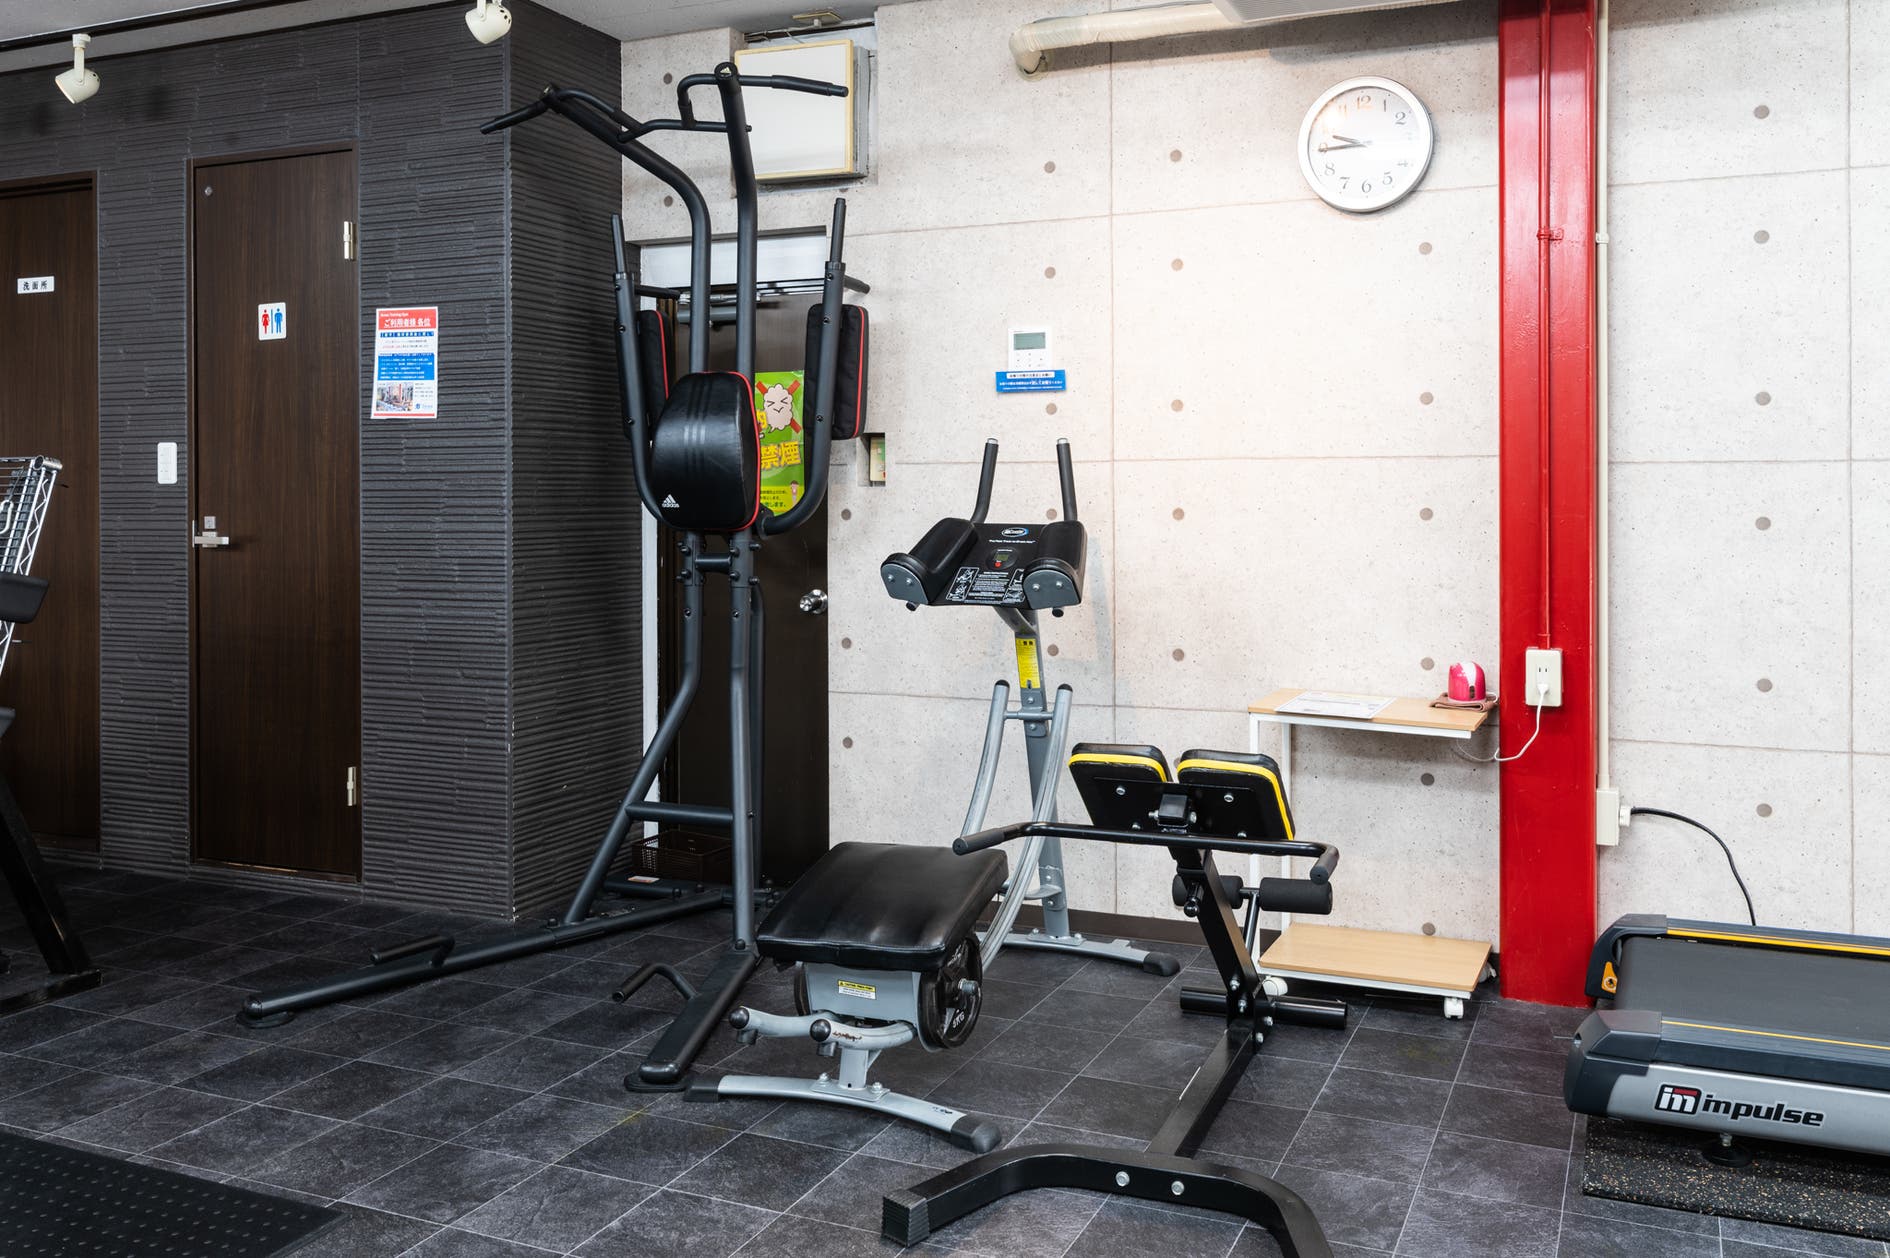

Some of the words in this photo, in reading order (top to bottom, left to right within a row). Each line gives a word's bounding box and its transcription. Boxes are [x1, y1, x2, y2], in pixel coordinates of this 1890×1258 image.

[1357, 96, 1372, 109] 12
[1384, 99, 1387, 112] 1
[1395, 111, 1407, 125] 2
[1324, 161, 1335, 176] 8
[1339, 176, 1350, 190] 7
[1382, 172, 1393, 185] 5
[1361, 179, 1372, 193] 6
[23, 280, 47, 290] 洗面所
[1702, 1094, 1825, 1127] impulse
